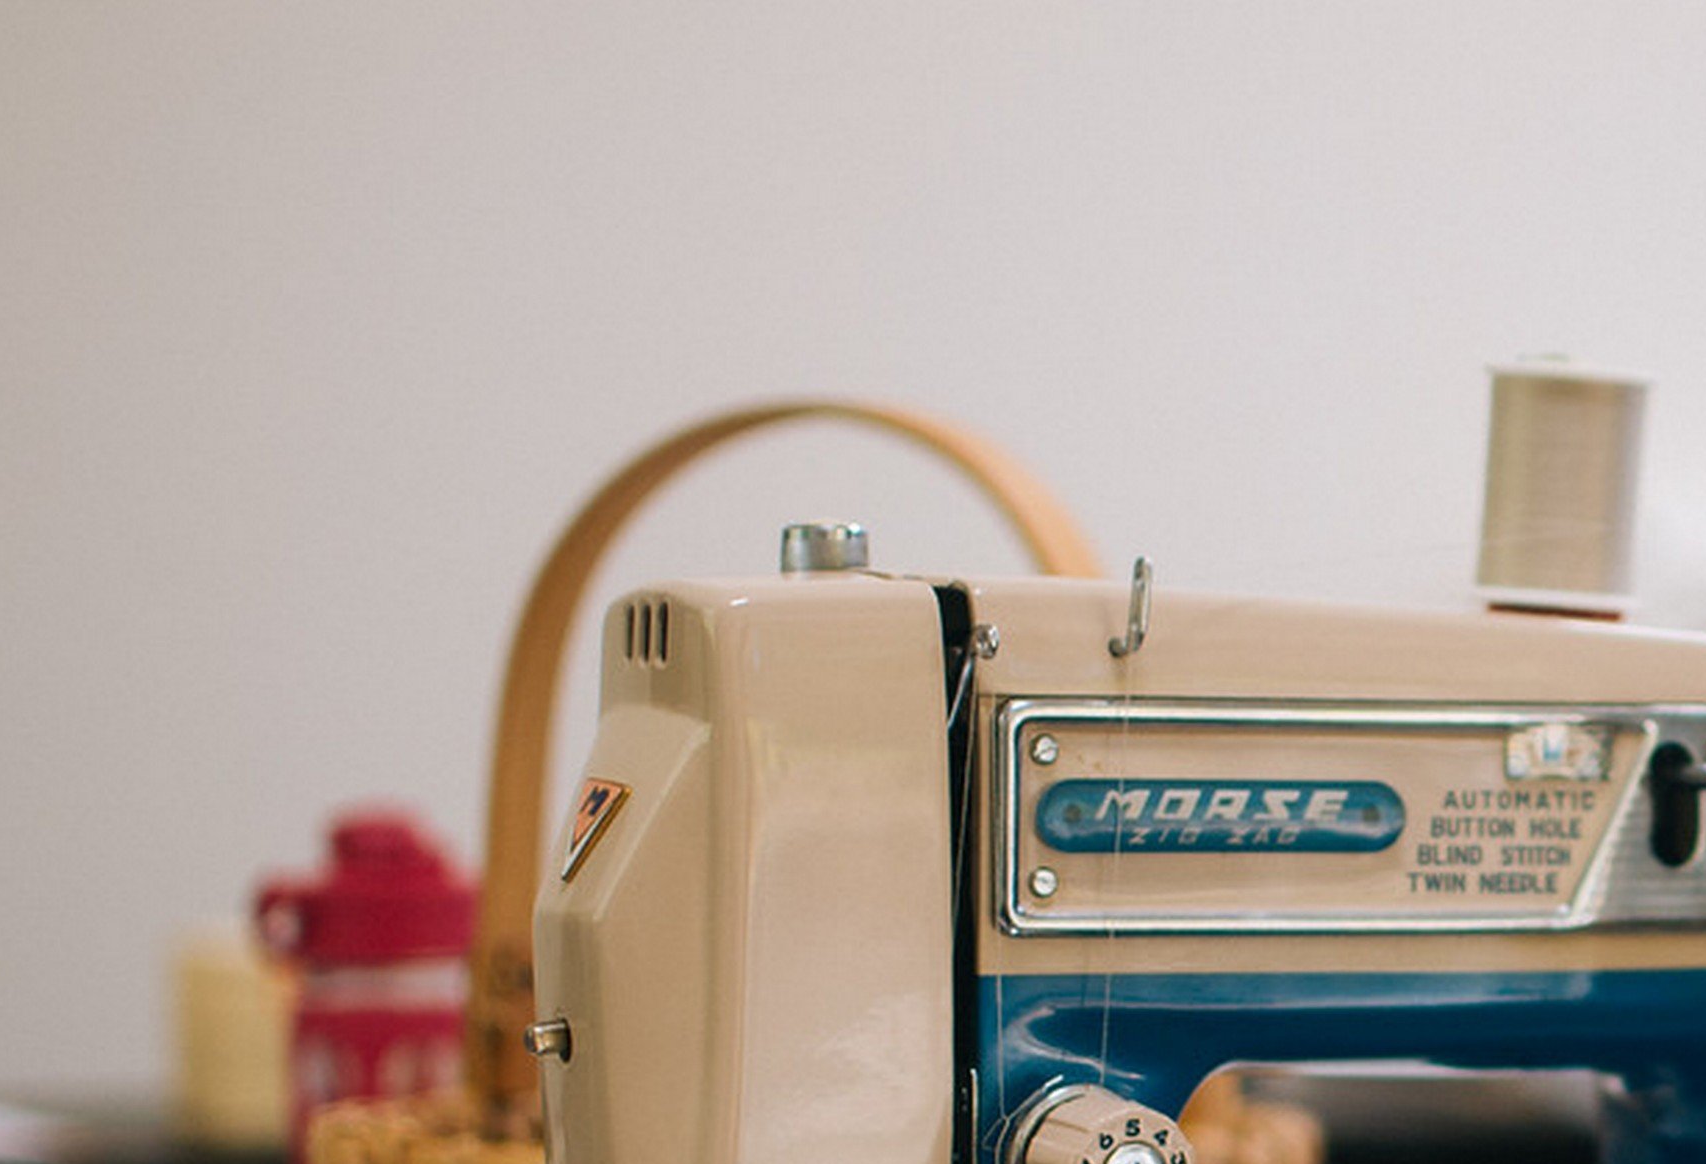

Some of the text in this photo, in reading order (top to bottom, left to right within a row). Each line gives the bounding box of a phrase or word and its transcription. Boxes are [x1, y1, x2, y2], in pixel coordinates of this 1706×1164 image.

[581, 786, 609, 816] M
[1095, 789, 1348, 821] MORSE
[1444, 790, 1595, 810] AUTOMATIC
[1129, 827, 1302, 844] ZIG ZAG
[1431, 816, 1580, 838] BUTTON HOLE
[1417, 844, 1570, 866] BLIND STITCH
[1407, 872, 1557, 893] TWIN NEEDLE
[1125, 1118, 1140, 1137] 5
[1153, 1129, 1168, 1146] 4
[1099, 1133, 1114, 1150] 6
